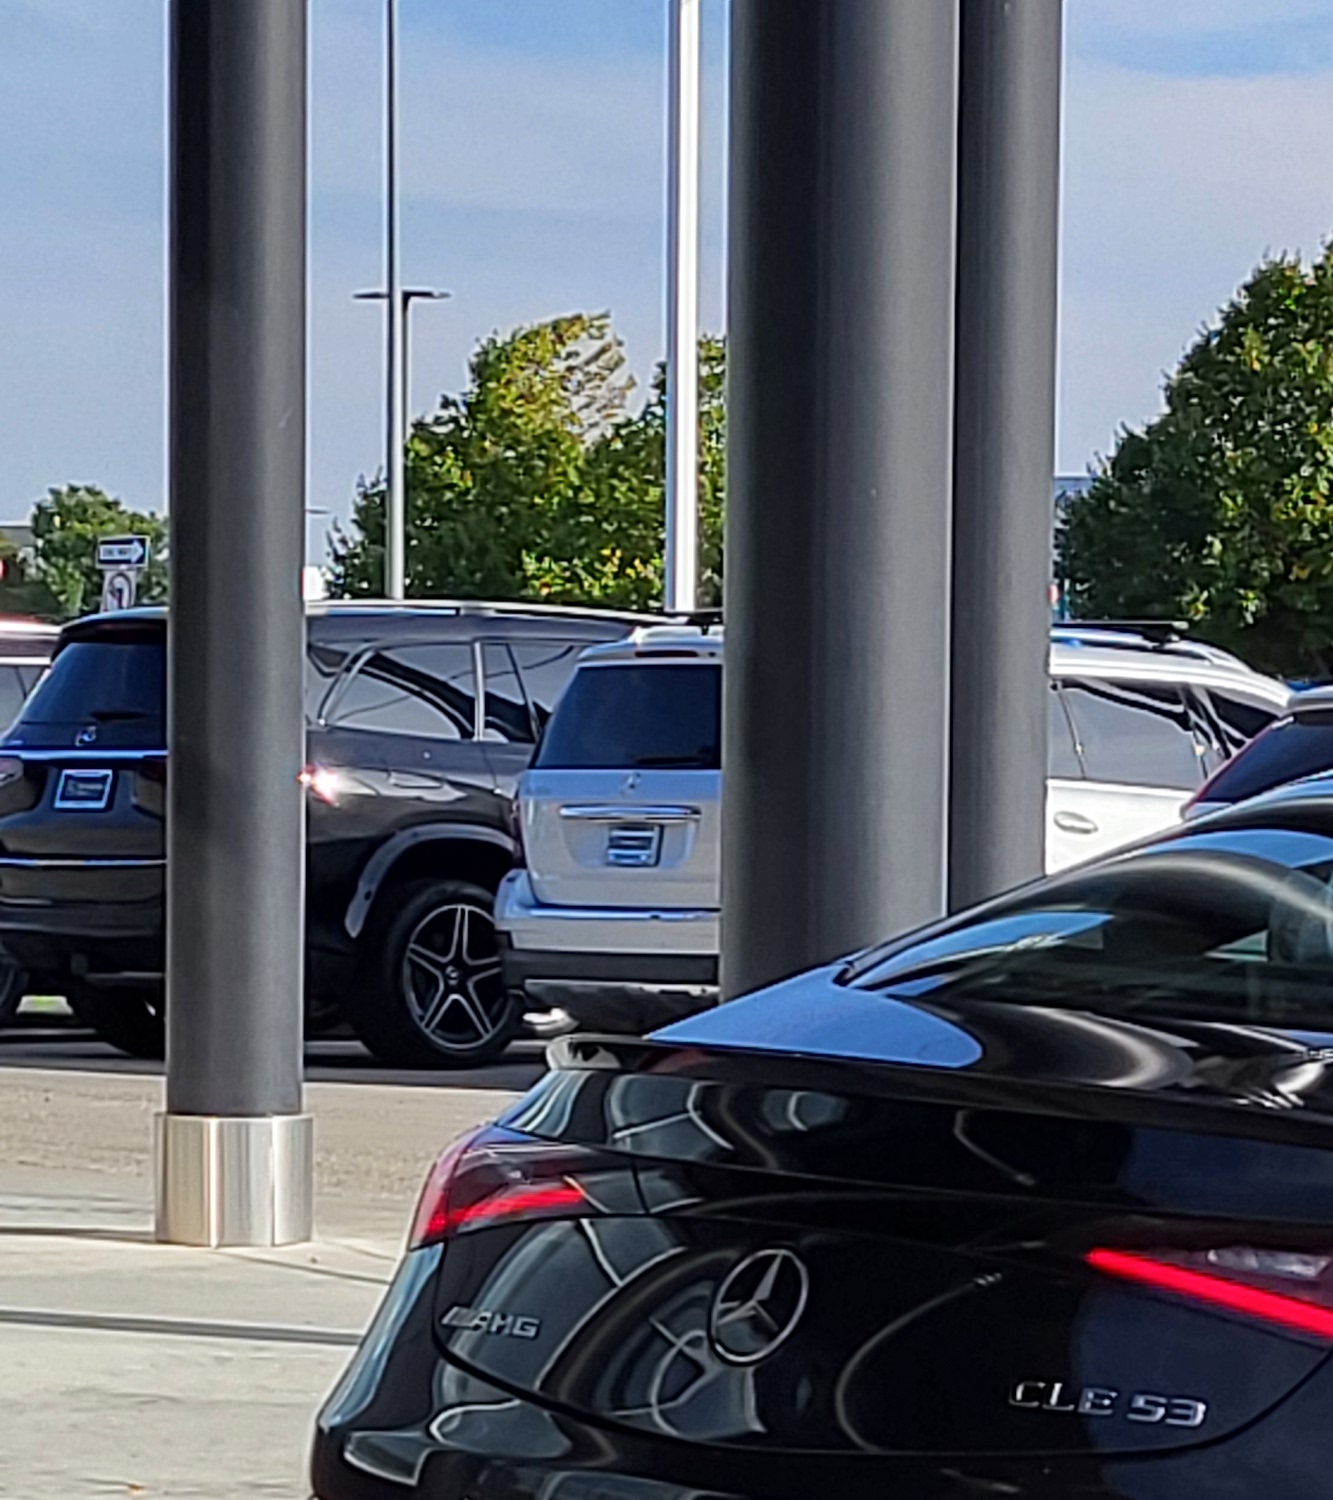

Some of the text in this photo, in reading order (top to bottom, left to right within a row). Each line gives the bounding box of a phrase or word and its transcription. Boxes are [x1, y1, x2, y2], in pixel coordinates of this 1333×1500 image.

[466, 1310, 541, 1338] AMG
[1008, 1381, 1206, 1427] CLE 53
